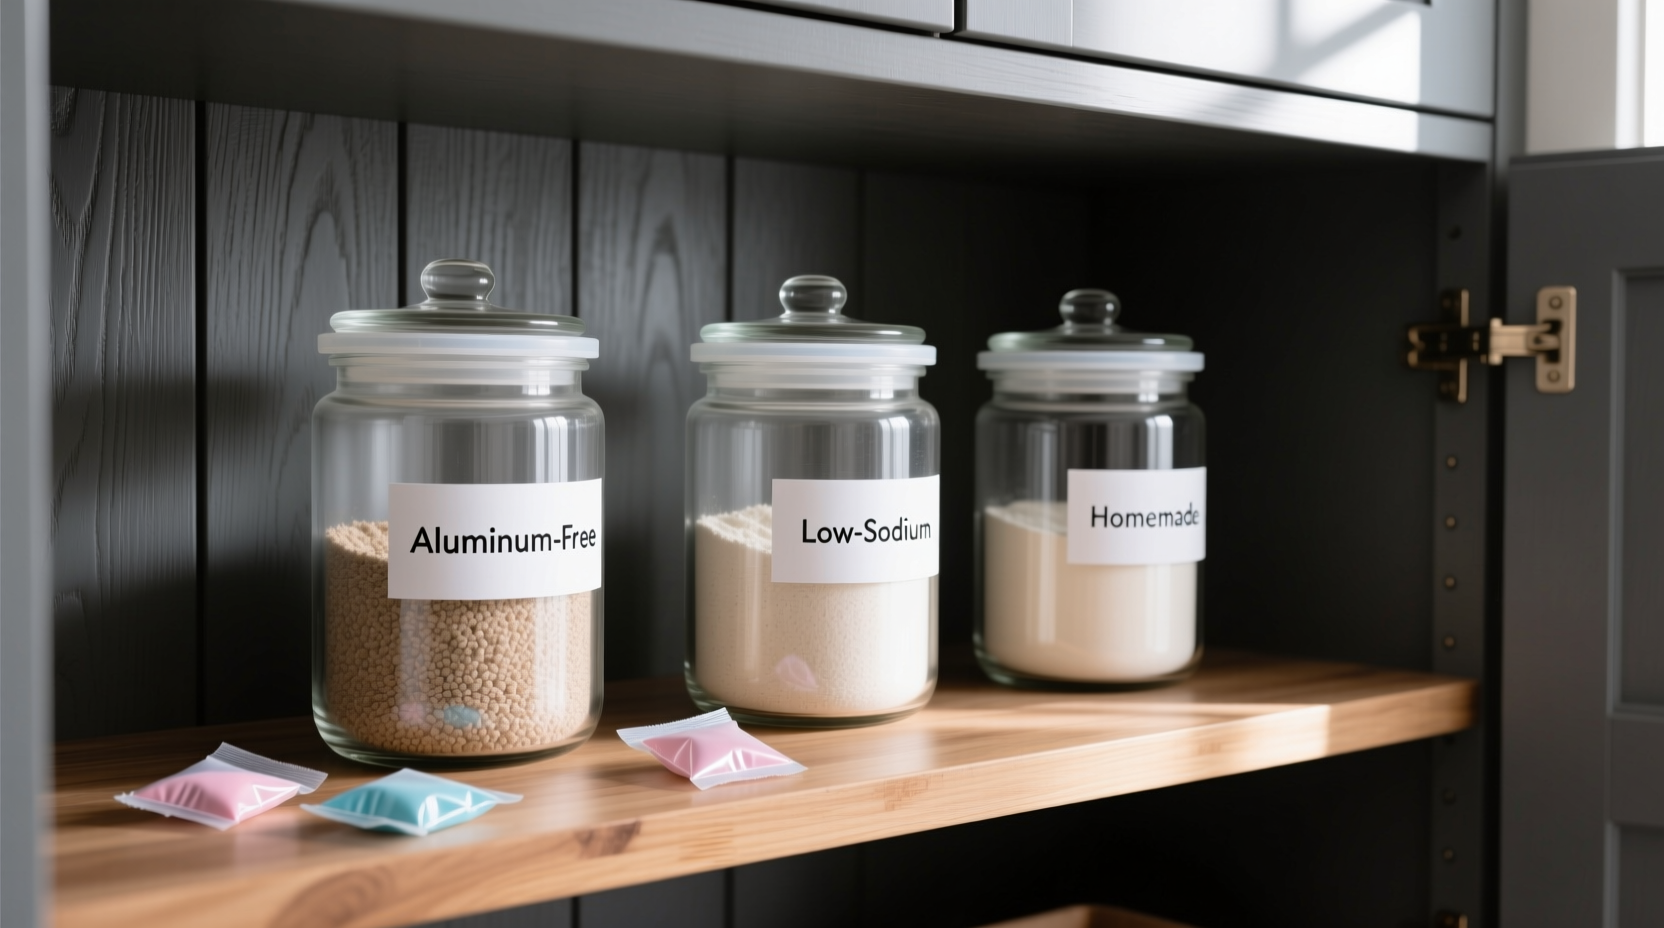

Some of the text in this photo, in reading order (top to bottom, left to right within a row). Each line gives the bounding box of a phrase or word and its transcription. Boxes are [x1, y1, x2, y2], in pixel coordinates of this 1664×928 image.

[1091, 502, 1200, 528] Homemade
[409, 524, 597, 554] Aluminum-Free
[802, 516, 931, 544] Low-Sodium
